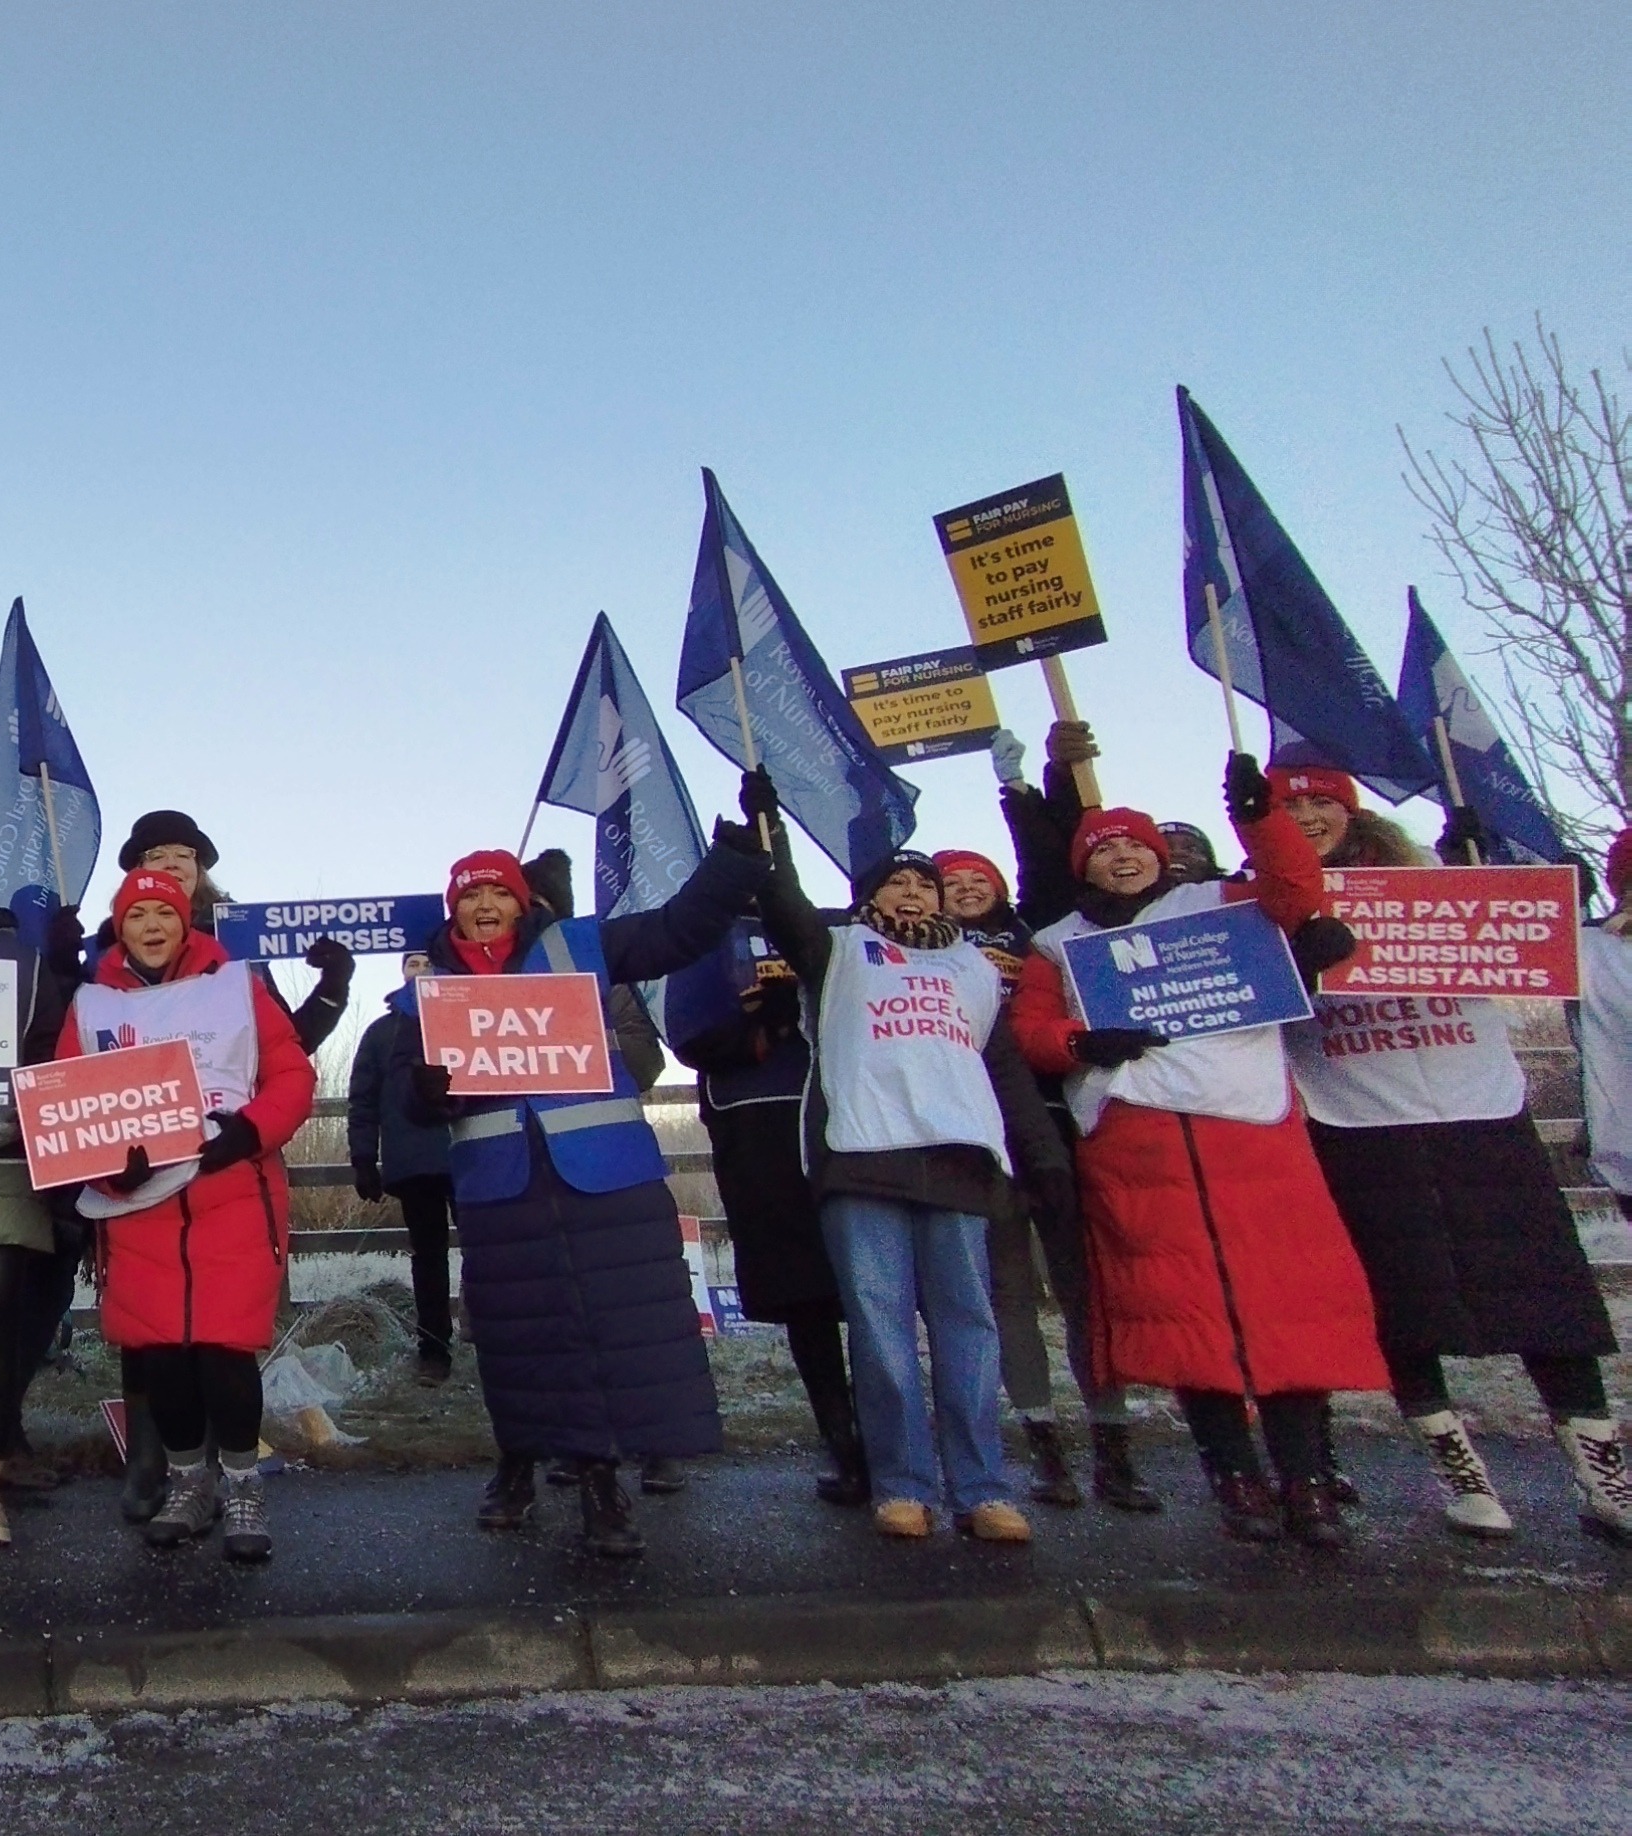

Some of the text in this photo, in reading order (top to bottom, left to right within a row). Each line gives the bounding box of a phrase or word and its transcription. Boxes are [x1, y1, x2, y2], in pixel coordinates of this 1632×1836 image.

[972, 499, 1028, 525] FAIR PAY
[977, 498, 1061, 534] FOR NURSING
[970, 534, 1055, 570] It's time
[985, 557, 1049, 585] to pay
[985, 575, 1064, 607] nursing
[978, 590, 1083, 629] staff fairly
[881, 659, 941, 679] FAIR PAY
[884, 663, 973, 688] FOR NURSING
[873, 687, 963, 712] It's time to
[746, 670, 841, 766] of Nursing
[872, 700, 972, 728] pay nursing
[881, 714, 968, 738] staff fairly
[787, 747, 841, 796] Ireland
[605, 824, 631, 847] of
[265, 901, 395, 929] SUPPORT
[1332, 900, 1559, 919] FAIR PAY FOR
[259, 927, 406, 956] NI NRSES
[1349, 922, 1551, 942] NURSES AND
[1372, 945, 1519, 964] NURSING
[901, 976, 954, 997] THE
[1131, 973, 1239, 1003] NI Nurses
[1346, 967, 1550, 988] ASSISTANTS
[867, 996, 952, 1017] VOICE
[1129, 985, 1256, 1021] Committed
[1320, 996, 1420, 1029] VOICE
[468, 1007, 554, 1037] PAY
[1152, 1010, 1242, 1035] To Care
[1321, 1021, 1476, 1057] NURSING
[440, 1044, 593, 1076] PARITY
[39, 1080, 182, 1127] SUPPORT
[35, 1106, 200, 1157] NI NURSES
